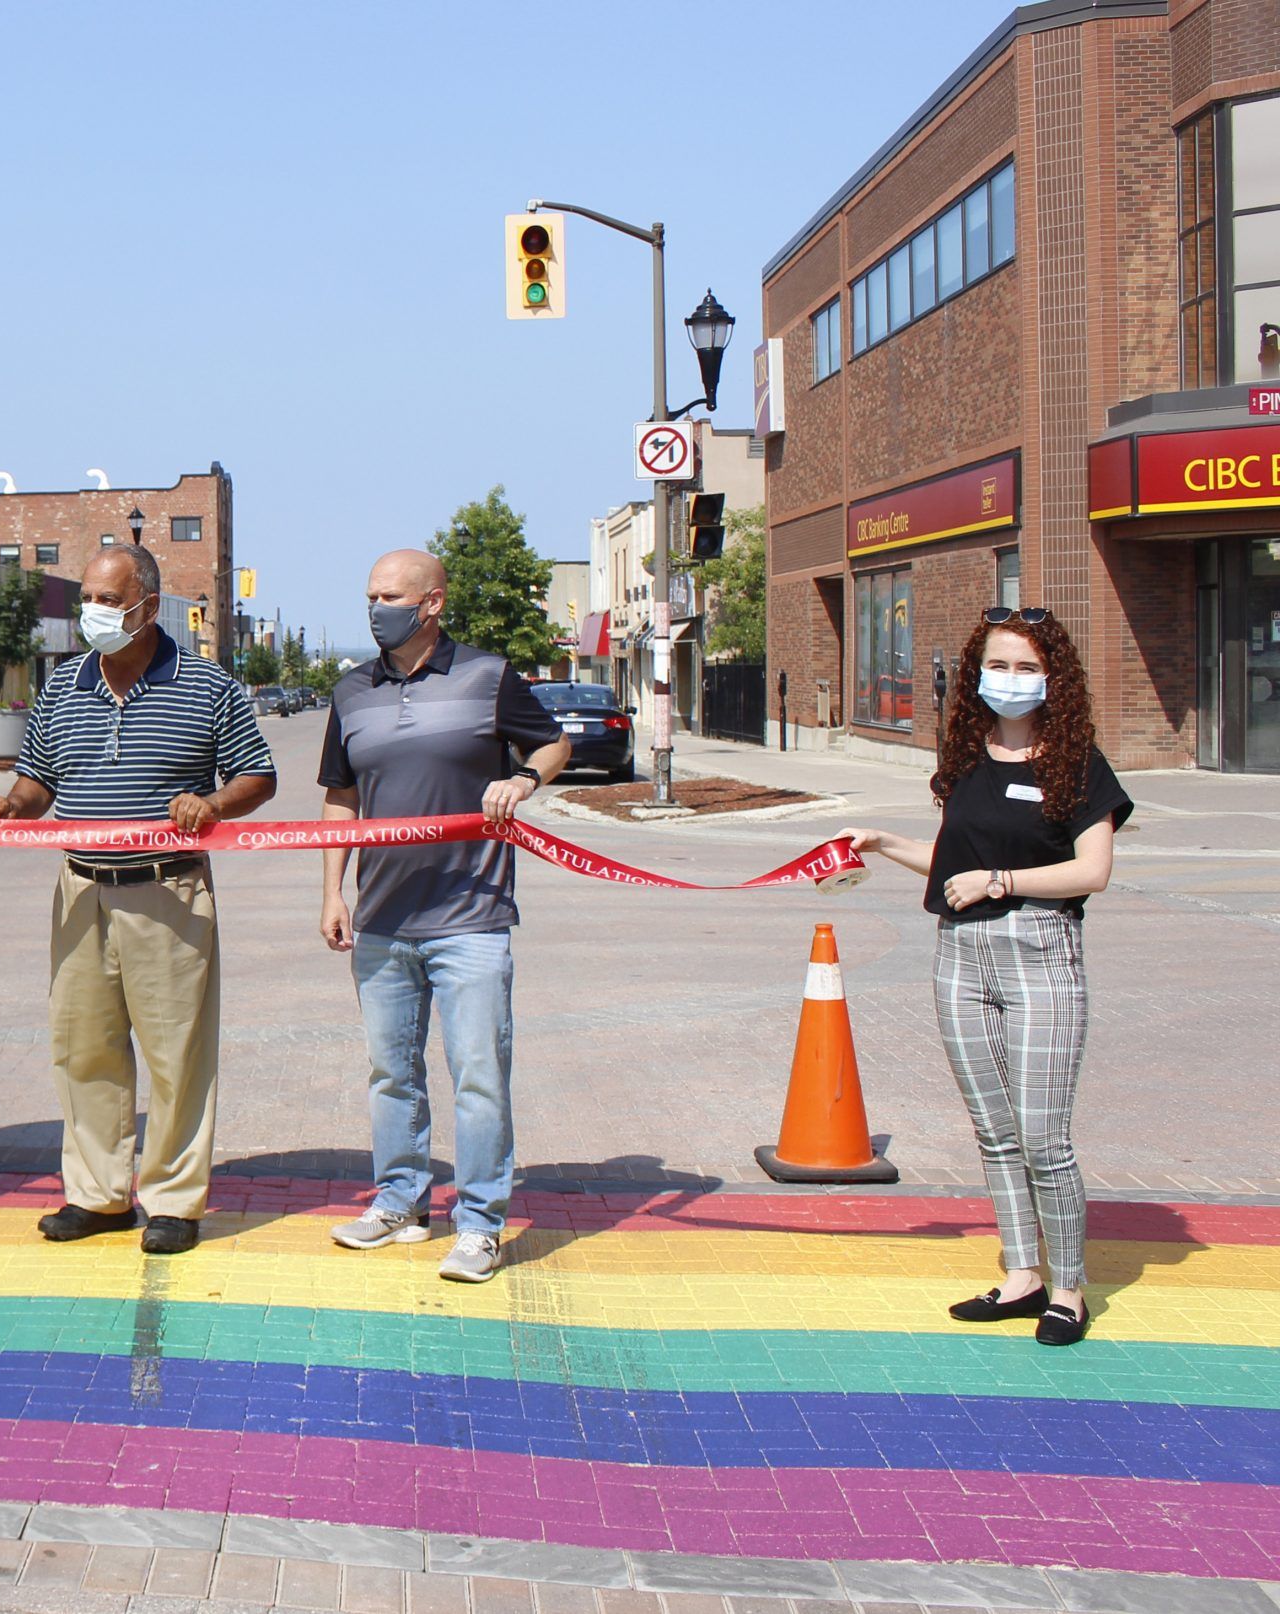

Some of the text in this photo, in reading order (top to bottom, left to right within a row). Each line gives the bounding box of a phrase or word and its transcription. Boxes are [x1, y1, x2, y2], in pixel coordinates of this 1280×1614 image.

[1184, 454, 1261, 492] CIBC
[869, 513, 889, 542] Banking
[890, 511, 909, 535] Centre
[0, 827, 201, 848] CONGRATULATIONS!
[236, 824, 445, 849] CONGRATULATIONS!
